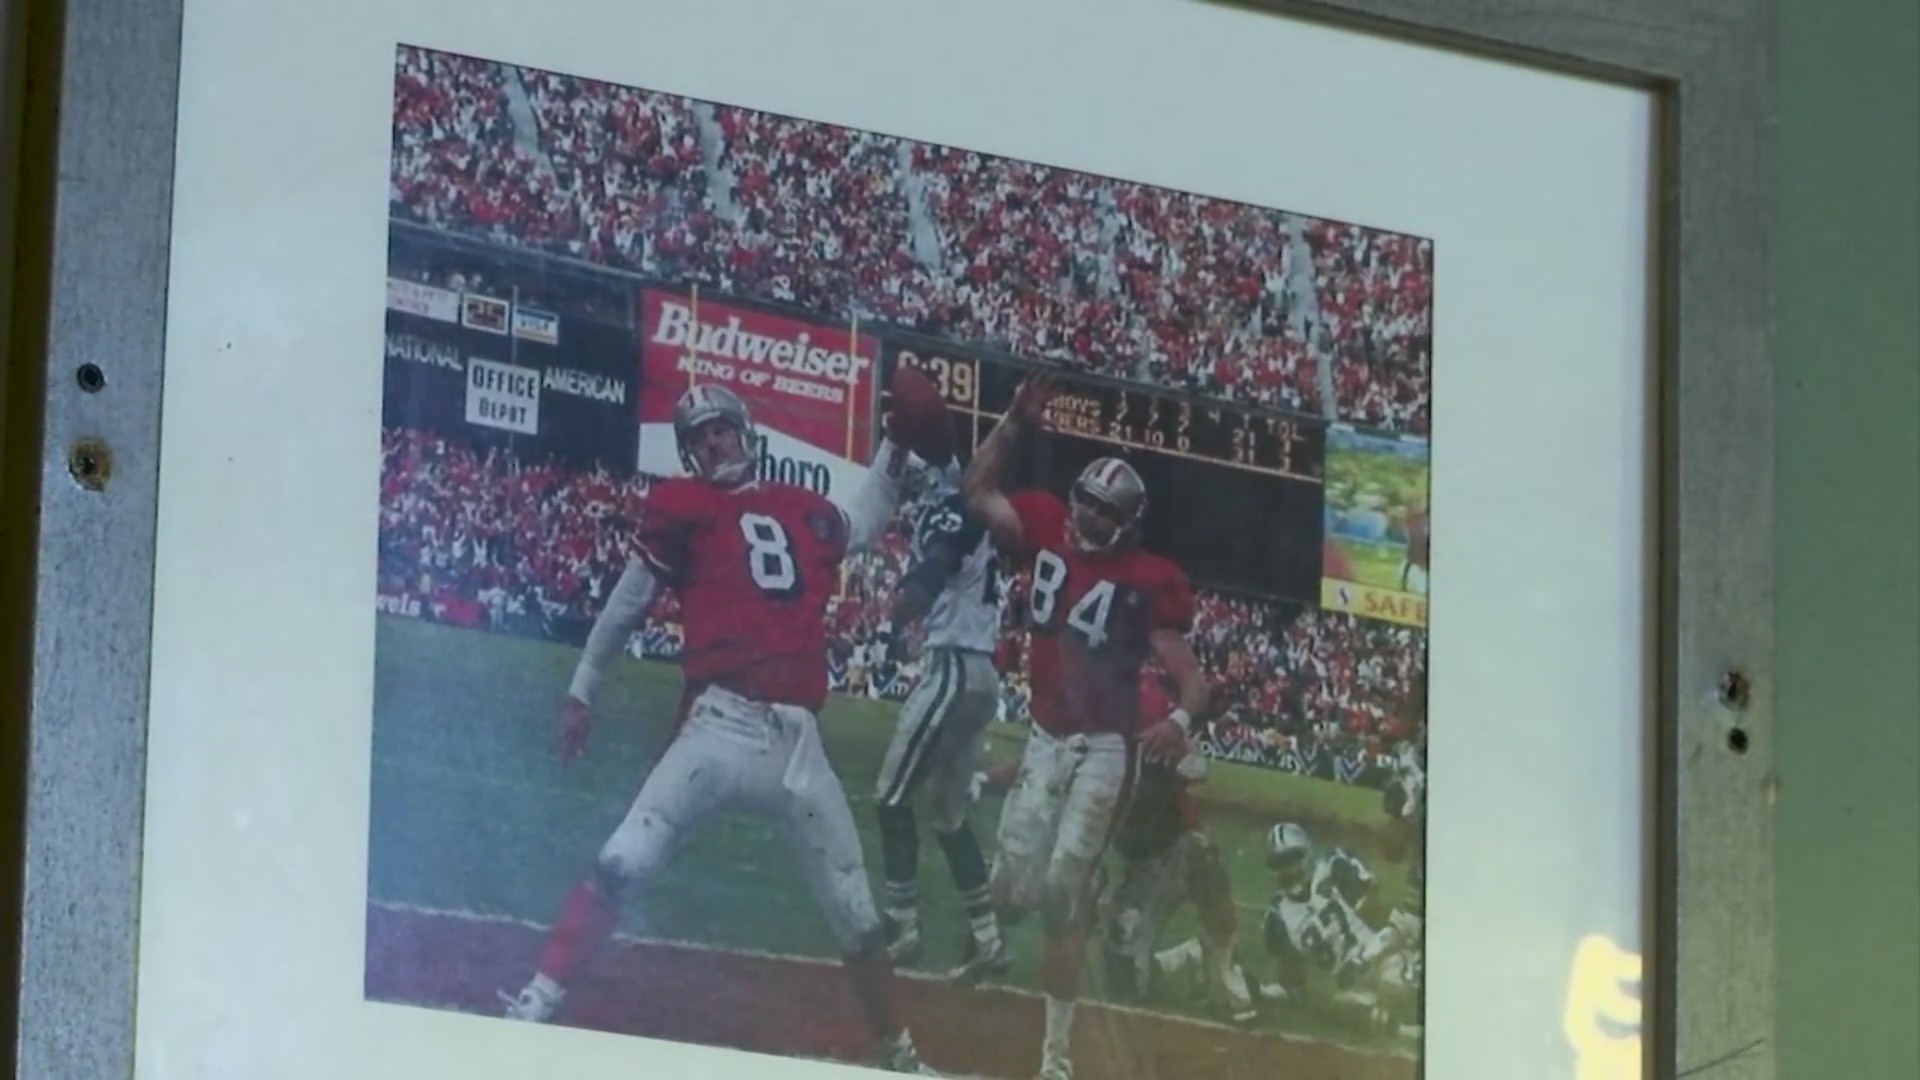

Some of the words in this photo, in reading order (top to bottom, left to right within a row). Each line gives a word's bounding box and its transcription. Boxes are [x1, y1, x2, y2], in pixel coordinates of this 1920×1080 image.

[652, 301, 870, 385] Budweiser
[471, 363, 537, 400] OFFICE
[542, 365, 626, 405] AMERICAN
[677, 355, 736, 379] KING
[739, 367, 771, 387] OF
[478, 398, 528, 426] DEPOT
[739, 512, 797, 591] 8
[1028, 548, 1117, 649] 84
